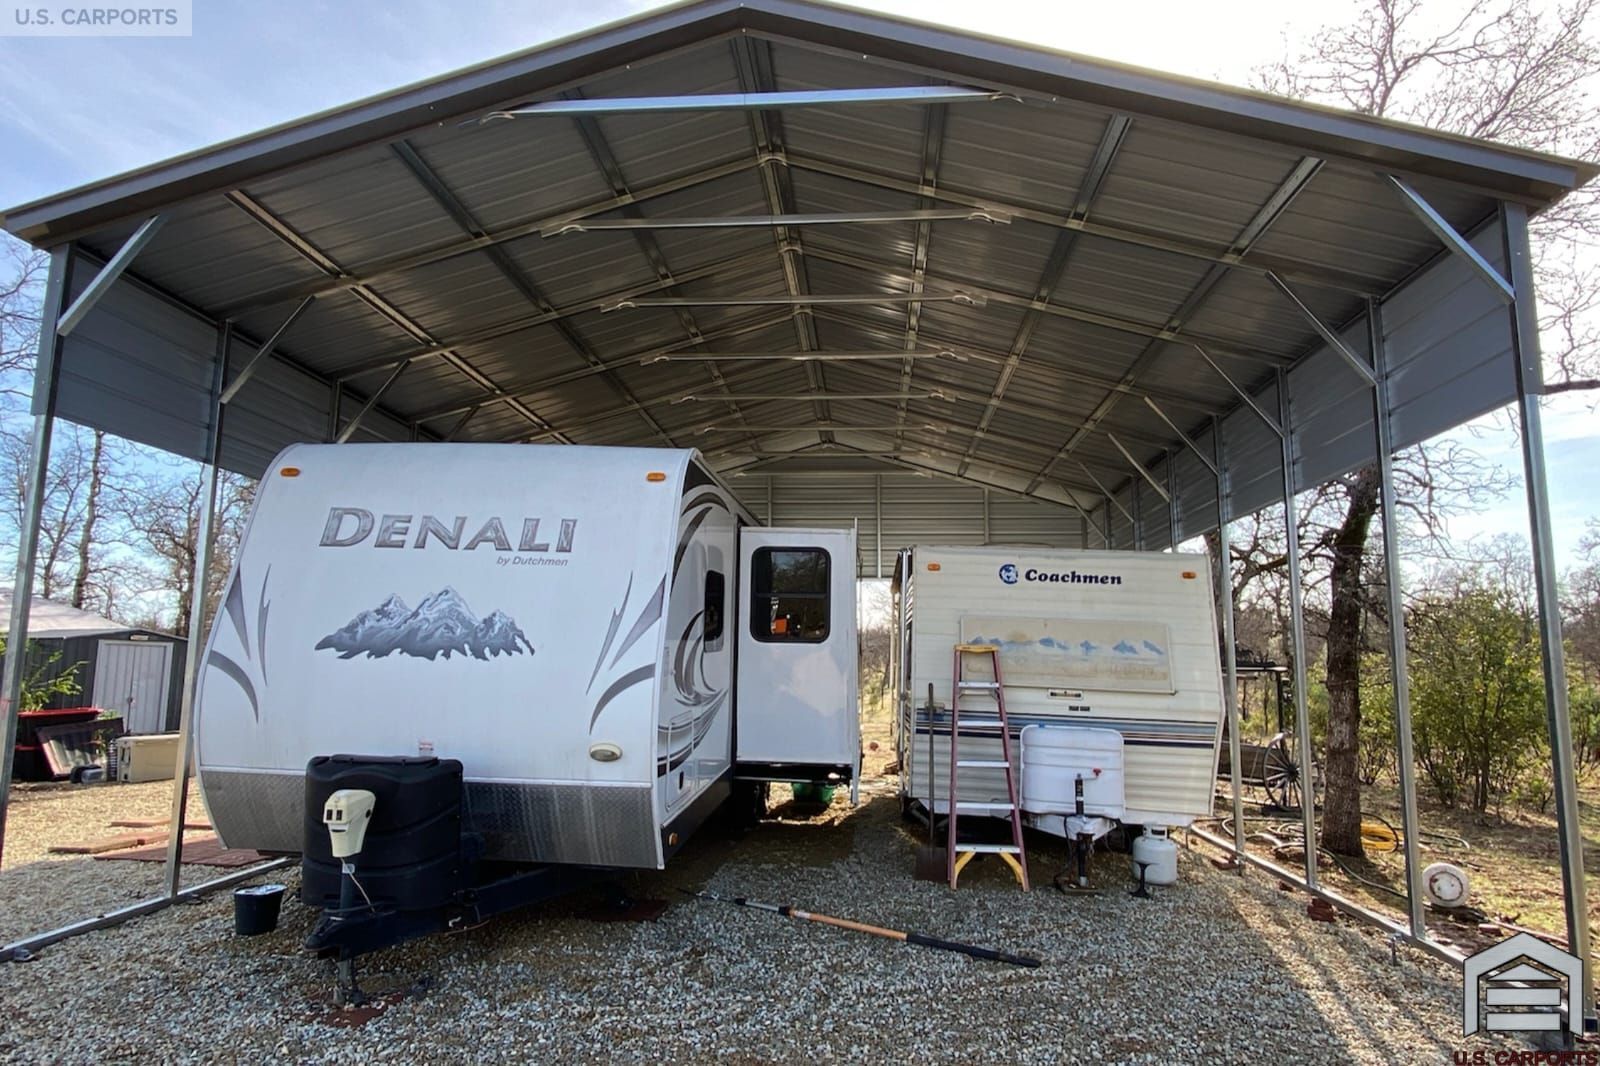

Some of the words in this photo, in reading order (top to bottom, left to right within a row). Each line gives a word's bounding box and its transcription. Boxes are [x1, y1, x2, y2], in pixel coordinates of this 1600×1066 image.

[319, 506, 578, 552] DENALI
[496, 556, 510, 567] by
[512, 555, 569, 567] Dutchmen
[1025, 569, 1122, 585] Coachmen
